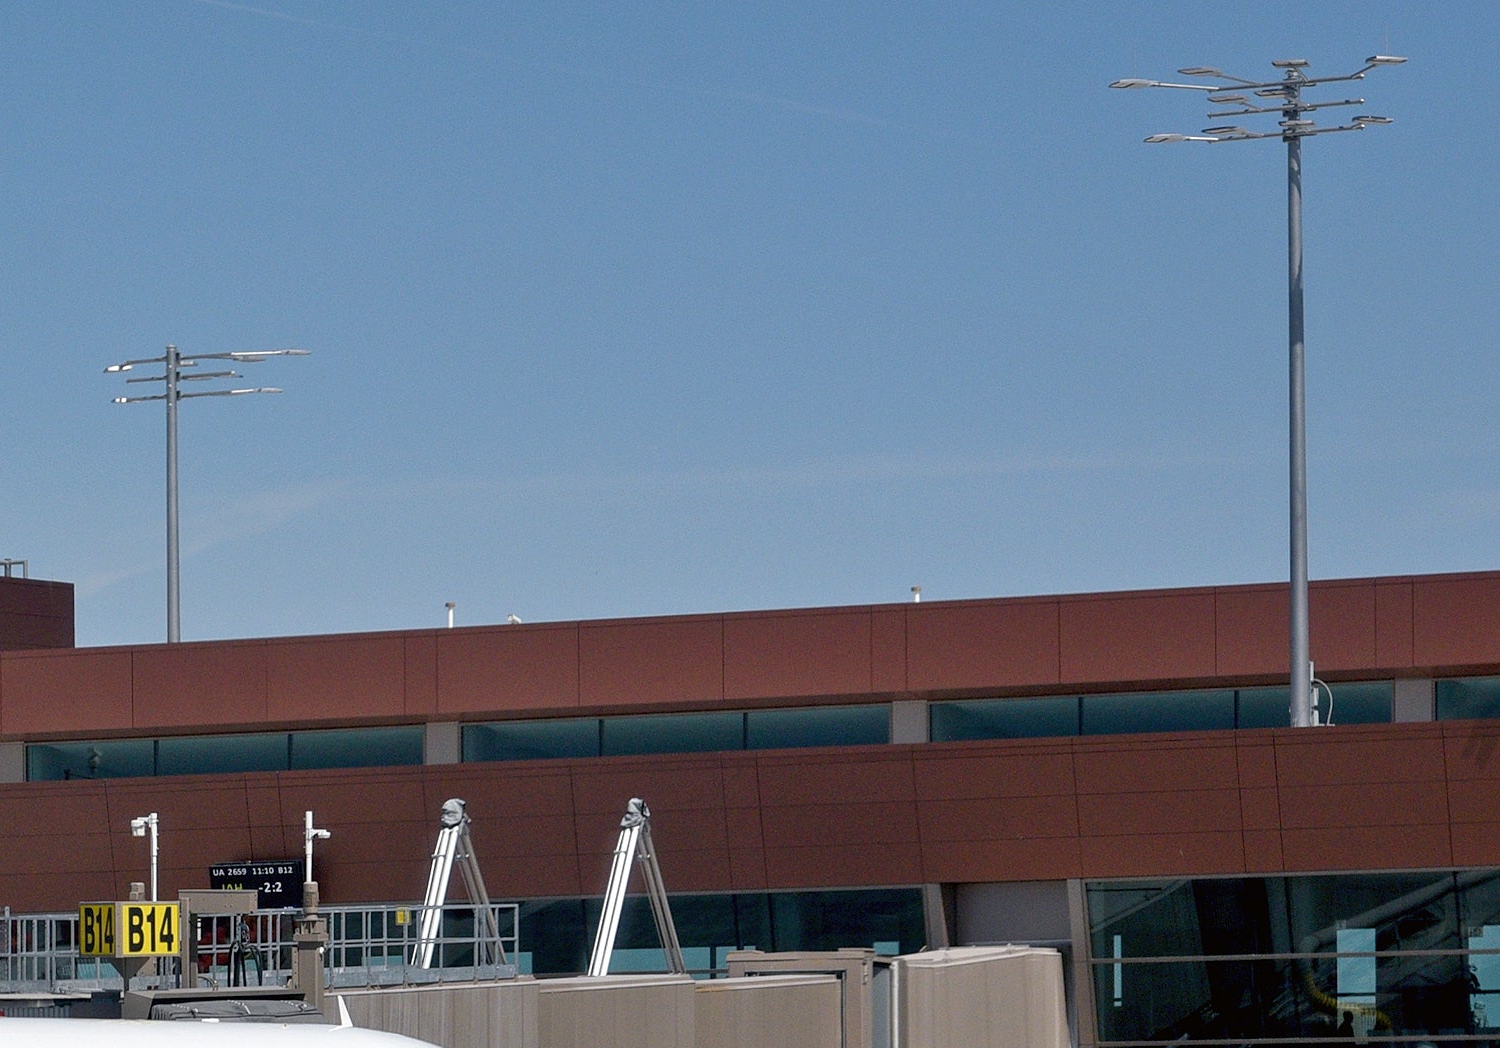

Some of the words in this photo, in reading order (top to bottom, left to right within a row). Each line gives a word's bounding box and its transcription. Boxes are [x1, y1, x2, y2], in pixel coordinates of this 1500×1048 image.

[227, 868, 247, 876] 2659
[252, 867, 274, 875] 11:10
[277, 866, 293, 874] B12
[84, 907, 114, 954] B14
[128, 906, 174, 953] B14
